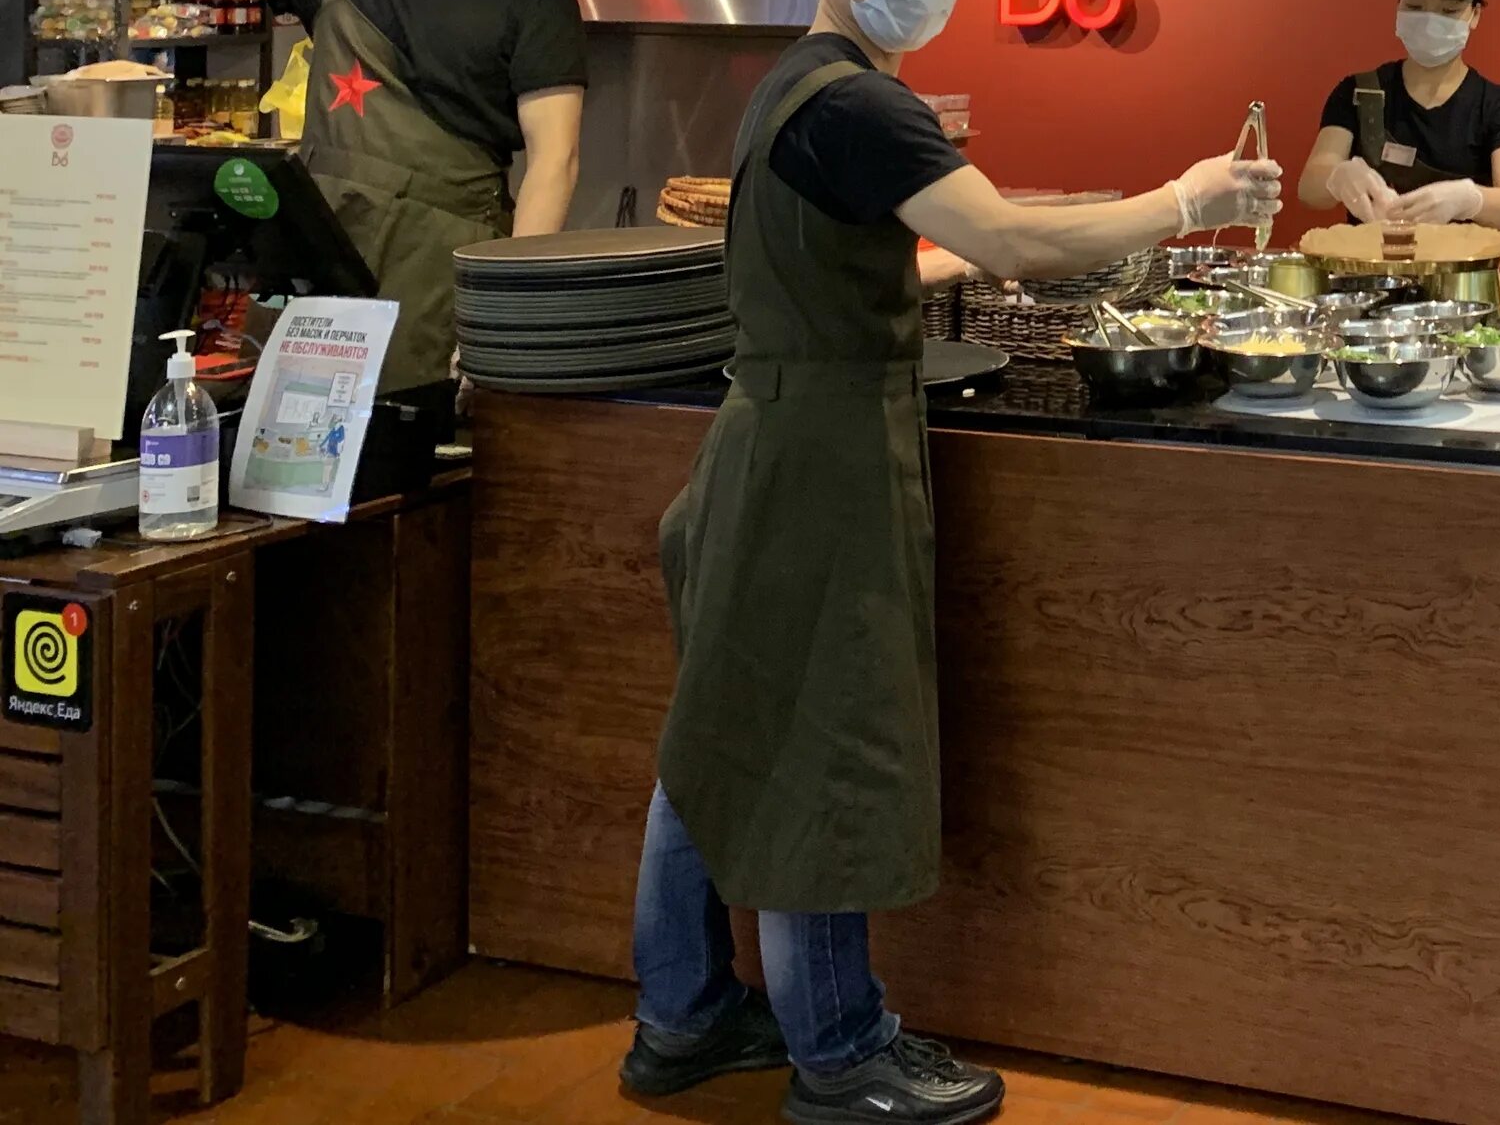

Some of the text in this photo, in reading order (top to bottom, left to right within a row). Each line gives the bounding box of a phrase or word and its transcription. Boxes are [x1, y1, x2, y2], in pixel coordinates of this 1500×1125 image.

[290, 315, 334, 328] ПОСЕТИТЕЛИ
[285, 326, 368, 344] БЕЗ МАСОК И ПЕРЧАТОК
[279, 339, 369, 361] НЕ ОБСЛУЖИВАЮТСЯ
[70, 612, 77, 627] 1
